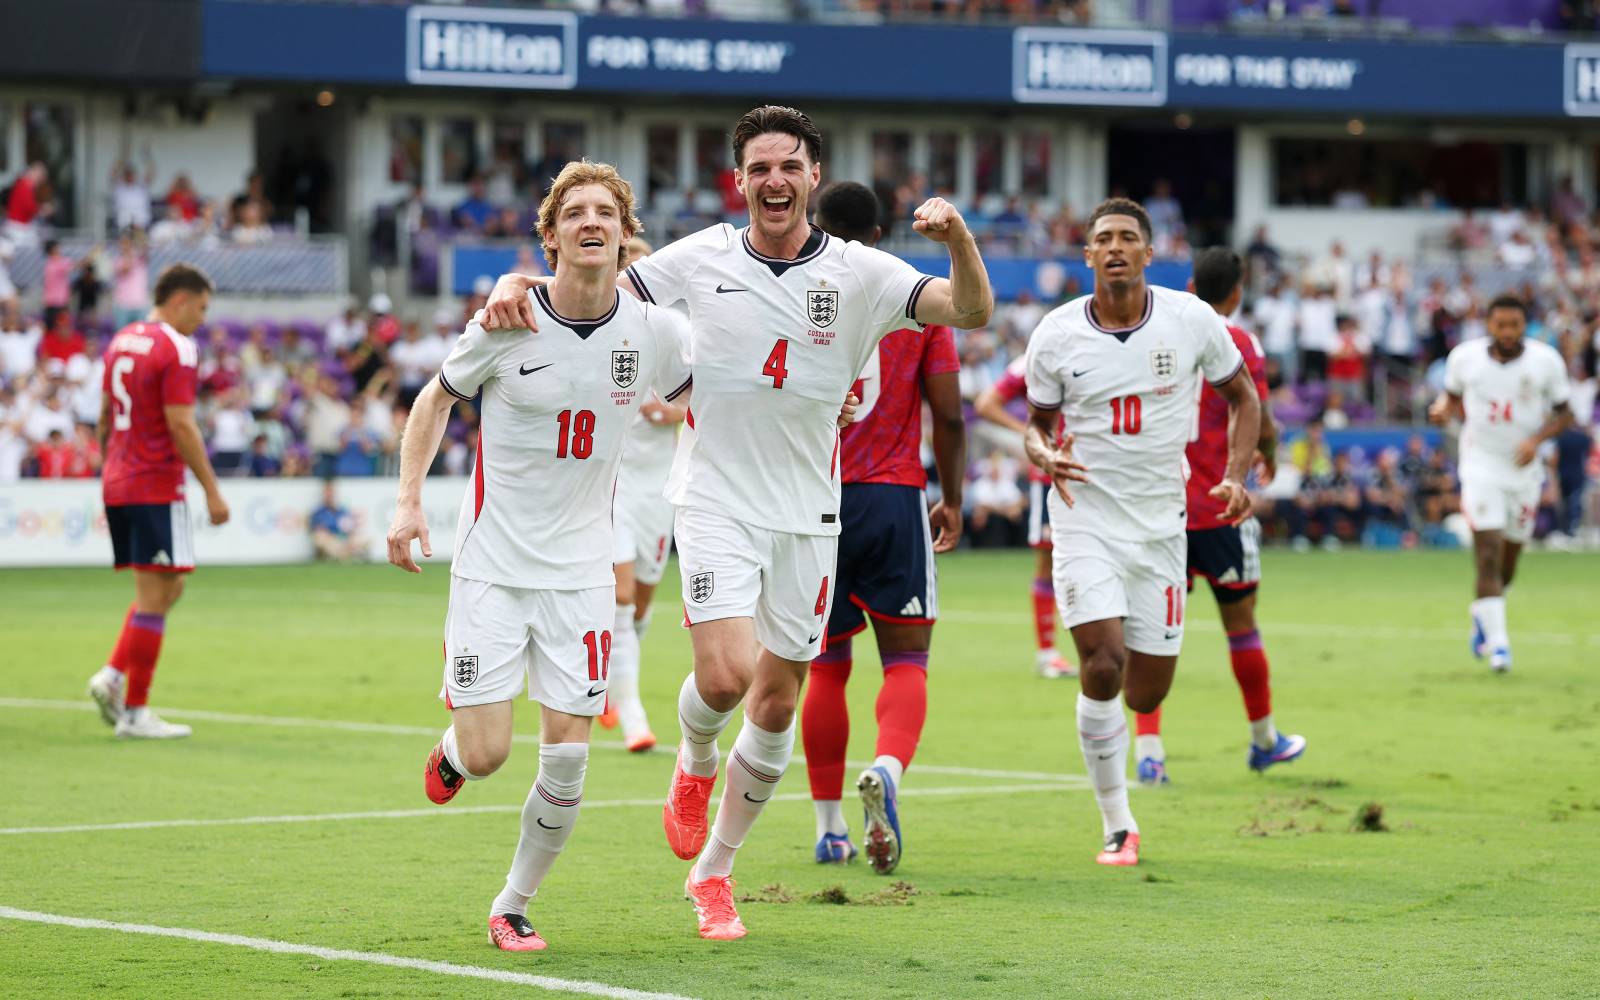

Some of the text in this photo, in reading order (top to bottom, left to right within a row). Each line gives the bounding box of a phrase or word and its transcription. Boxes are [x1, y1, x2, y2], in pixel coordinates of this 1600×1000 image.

[422, 20, 562, 74] Hilton
[587, 35, 788, 73] FOR THE STAY
[1029, 43, 1153, 90] Hilton
[1175, 54, 1357, 89] FOR THE STAY
[808, 330, 825, 338] COSTA
[762, 338, 789, 389] 4
[112, 355, 135, 431] 5
[1110, 394, 1142, 435] 10
[1488, 401, 1513, 424] 24
[556, 409, 596, 460] 18
[814, 575, 829, 623] 4
[583, 629, 612, 681] 18
